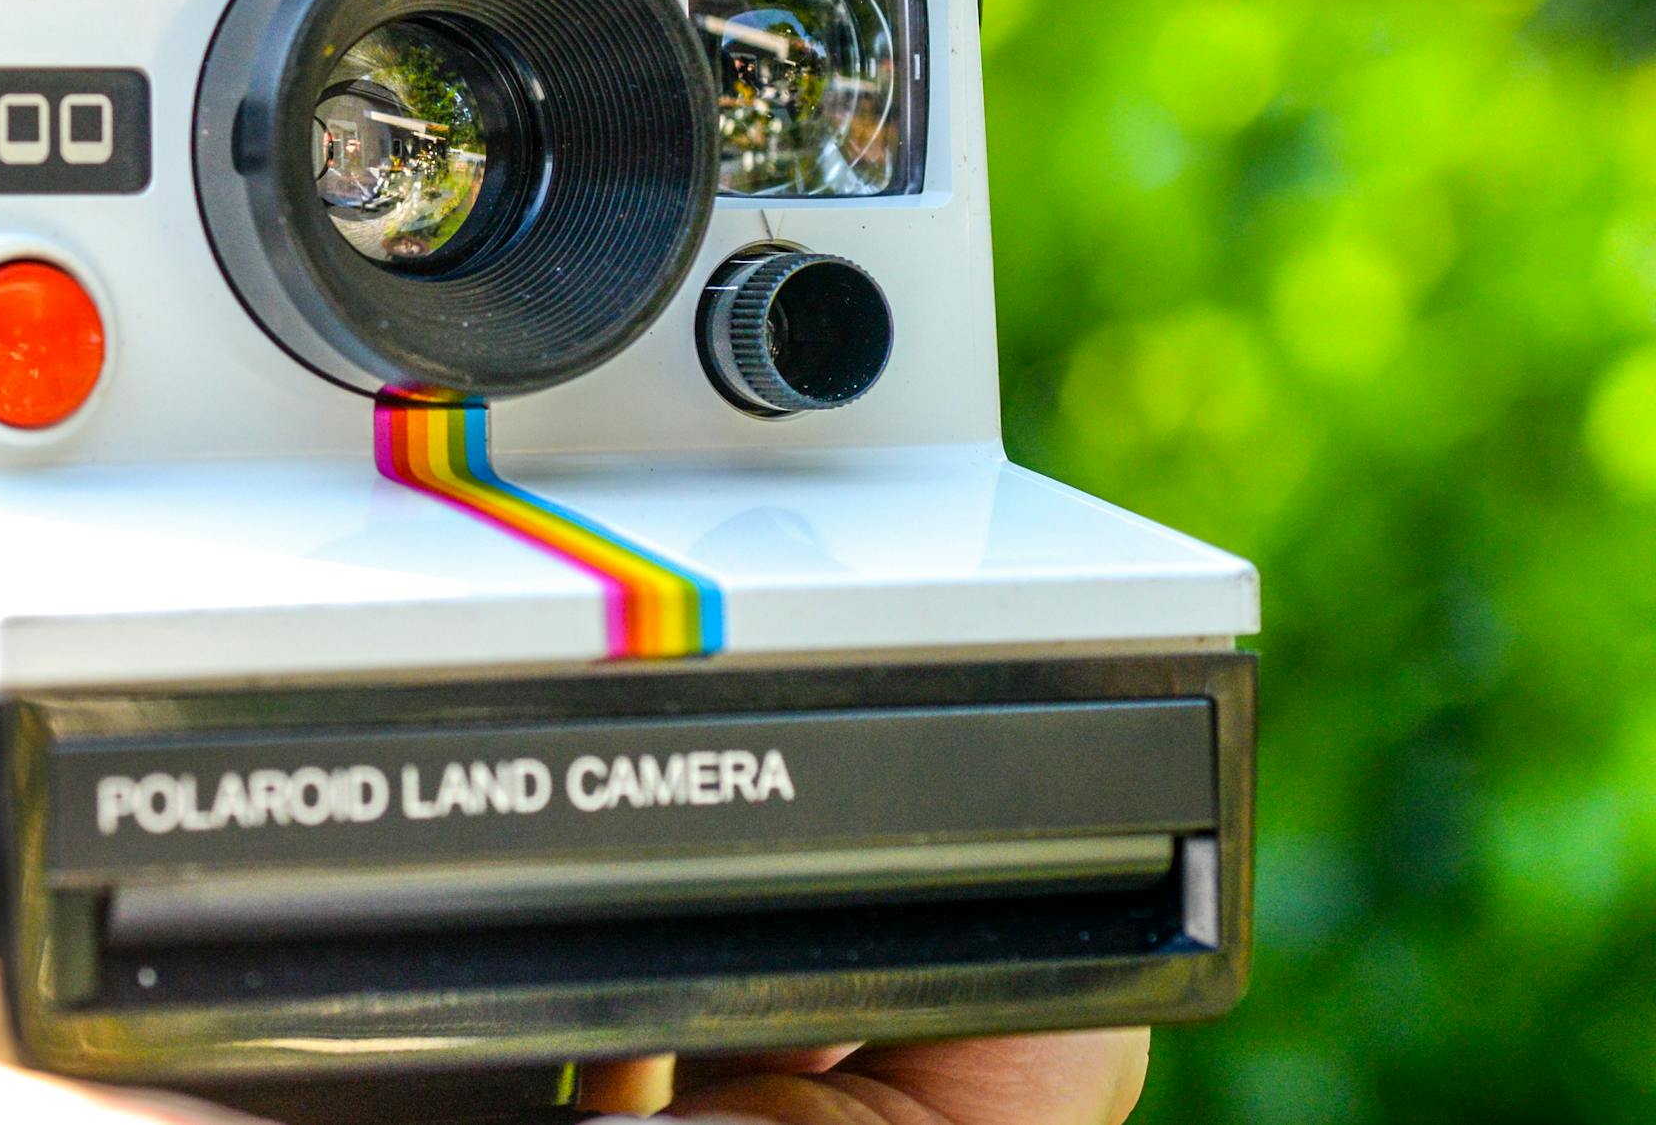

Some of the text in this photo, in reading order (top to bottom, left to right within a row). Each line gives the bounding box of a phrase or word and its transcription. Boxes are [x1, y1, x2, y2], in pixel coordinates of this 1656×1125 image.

[96, 749, 795, 835] POLAROID LAND CAMERA
